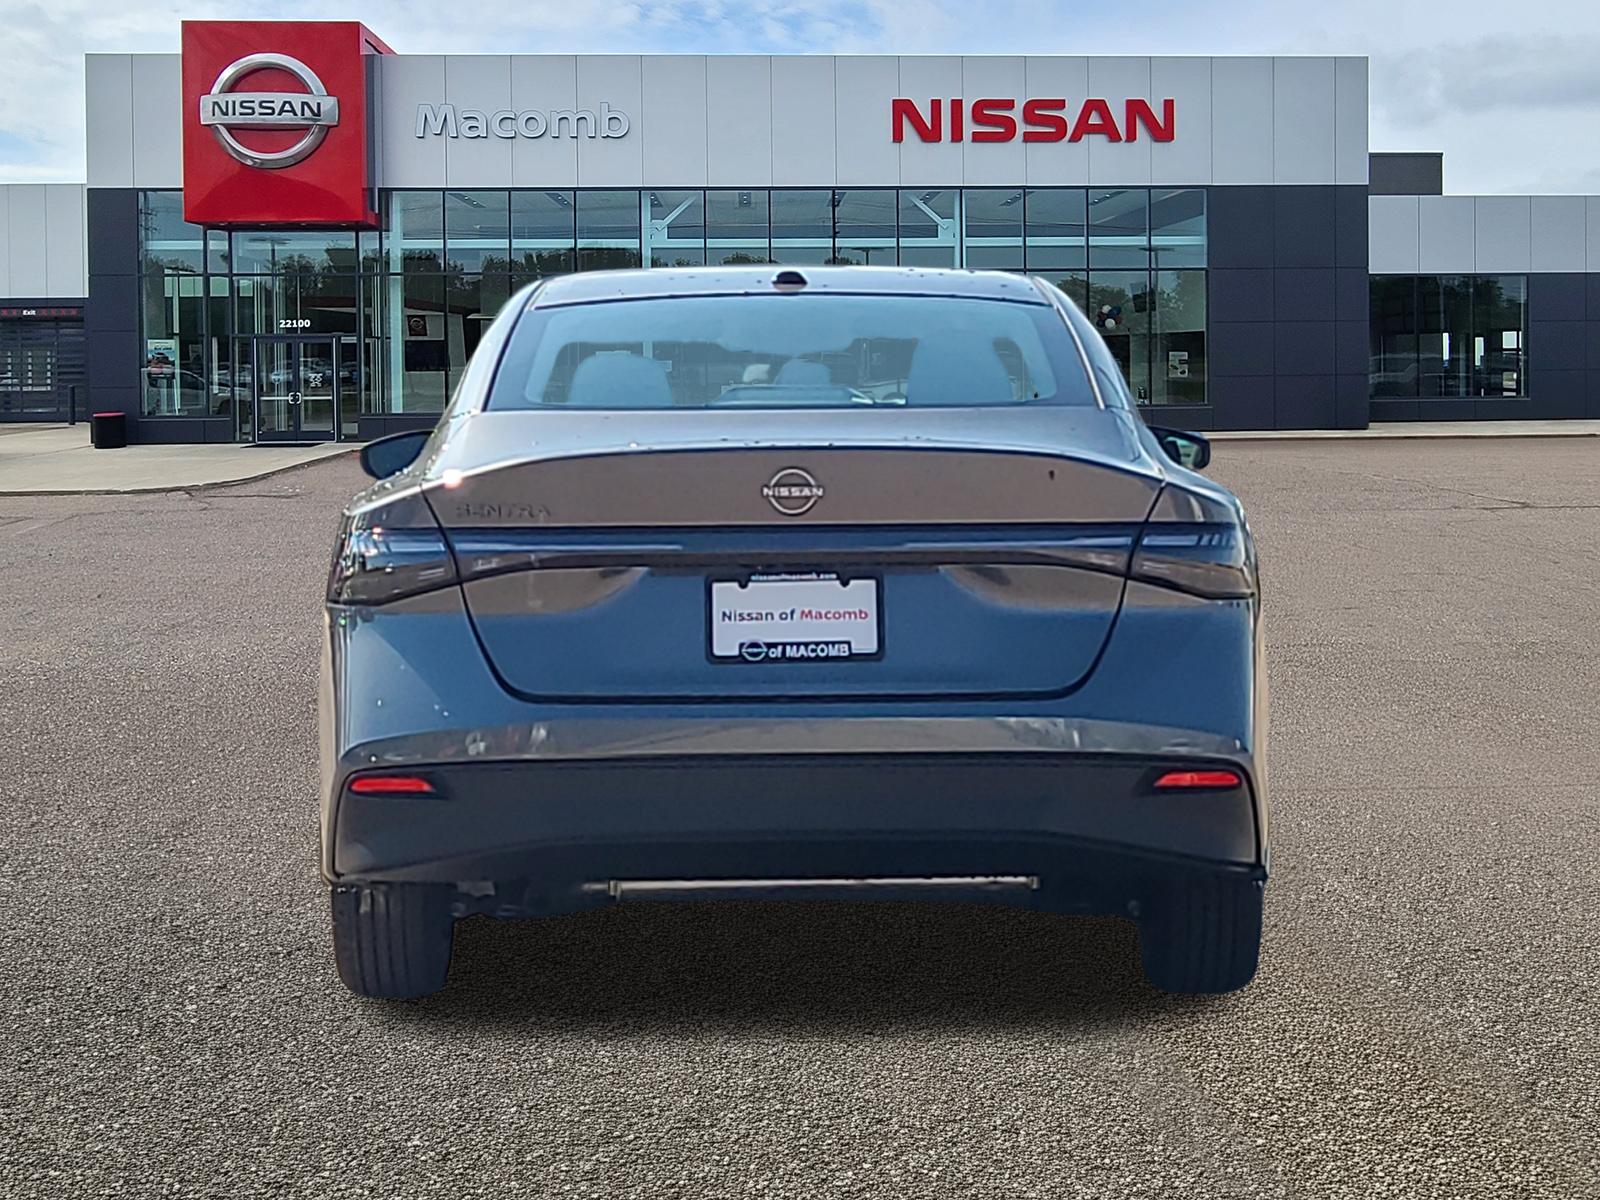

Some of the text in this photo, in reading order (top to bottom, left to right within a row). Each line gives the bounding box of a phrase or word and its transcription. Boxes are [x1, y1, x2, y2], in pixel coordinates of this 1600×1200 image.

[211, 99, 322, 118] NISSAN
[415, 102, 630, 139] Macomb
[892, 98, 1175, 143] NISSAN
[279, 319, 311, 328] 22100
[763, 486, 823, 497] NISSAN
[721, 608, 869, 622] Nissan of Macomb
[768, 643, 850, 659] of MACOMB
